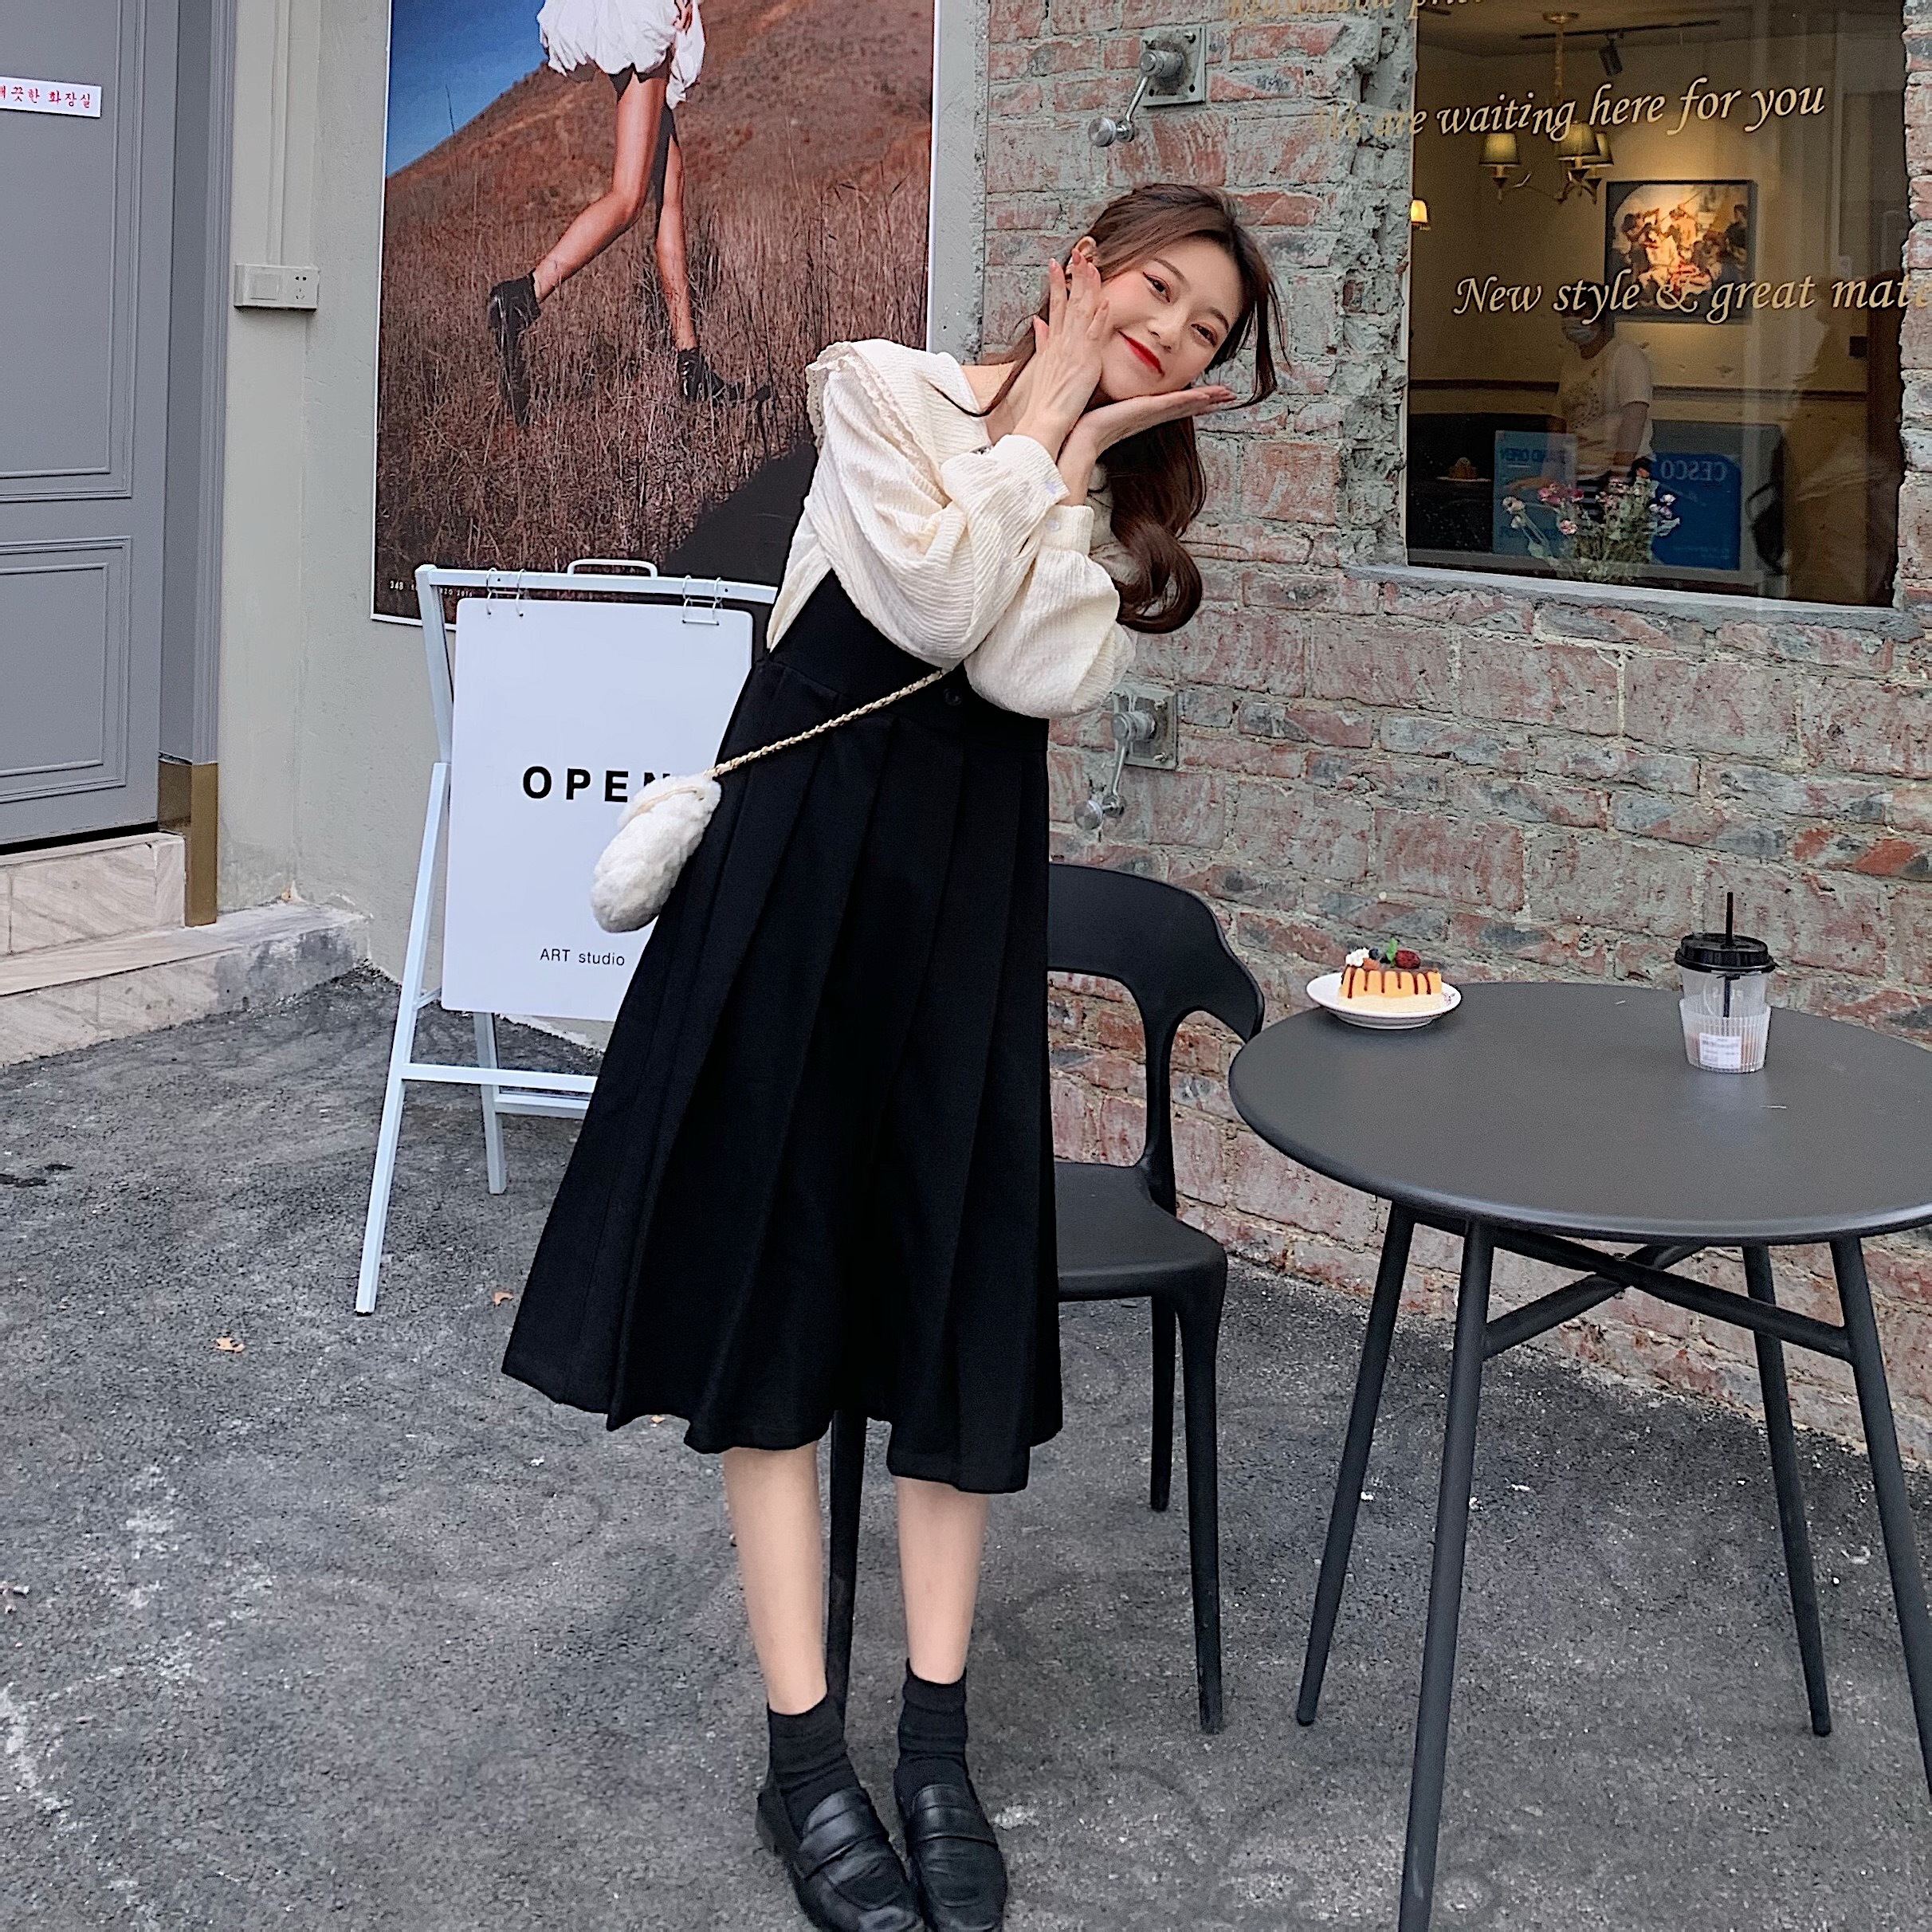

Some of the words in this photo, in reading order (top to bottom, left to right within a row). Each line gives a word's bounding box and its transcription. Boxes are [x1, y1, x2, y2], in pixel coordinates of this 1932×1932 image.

[49, 89, 91, 108] 화장실
[1436, 92, 1577, 142] waiting
[1588, 82, 1666, 125] here
[1666, 77, 1742, 135] for
[1744, 86, 1825, 132] you
[1453, 276, 1542, 314] New
[1553, 268, 1640, 325] style
[1655, 283, 1698, 313] &
[1706, 274, 1816, 324] great
[540, 948, 571, 962] ART
[579, 952, 625, 966] studio
